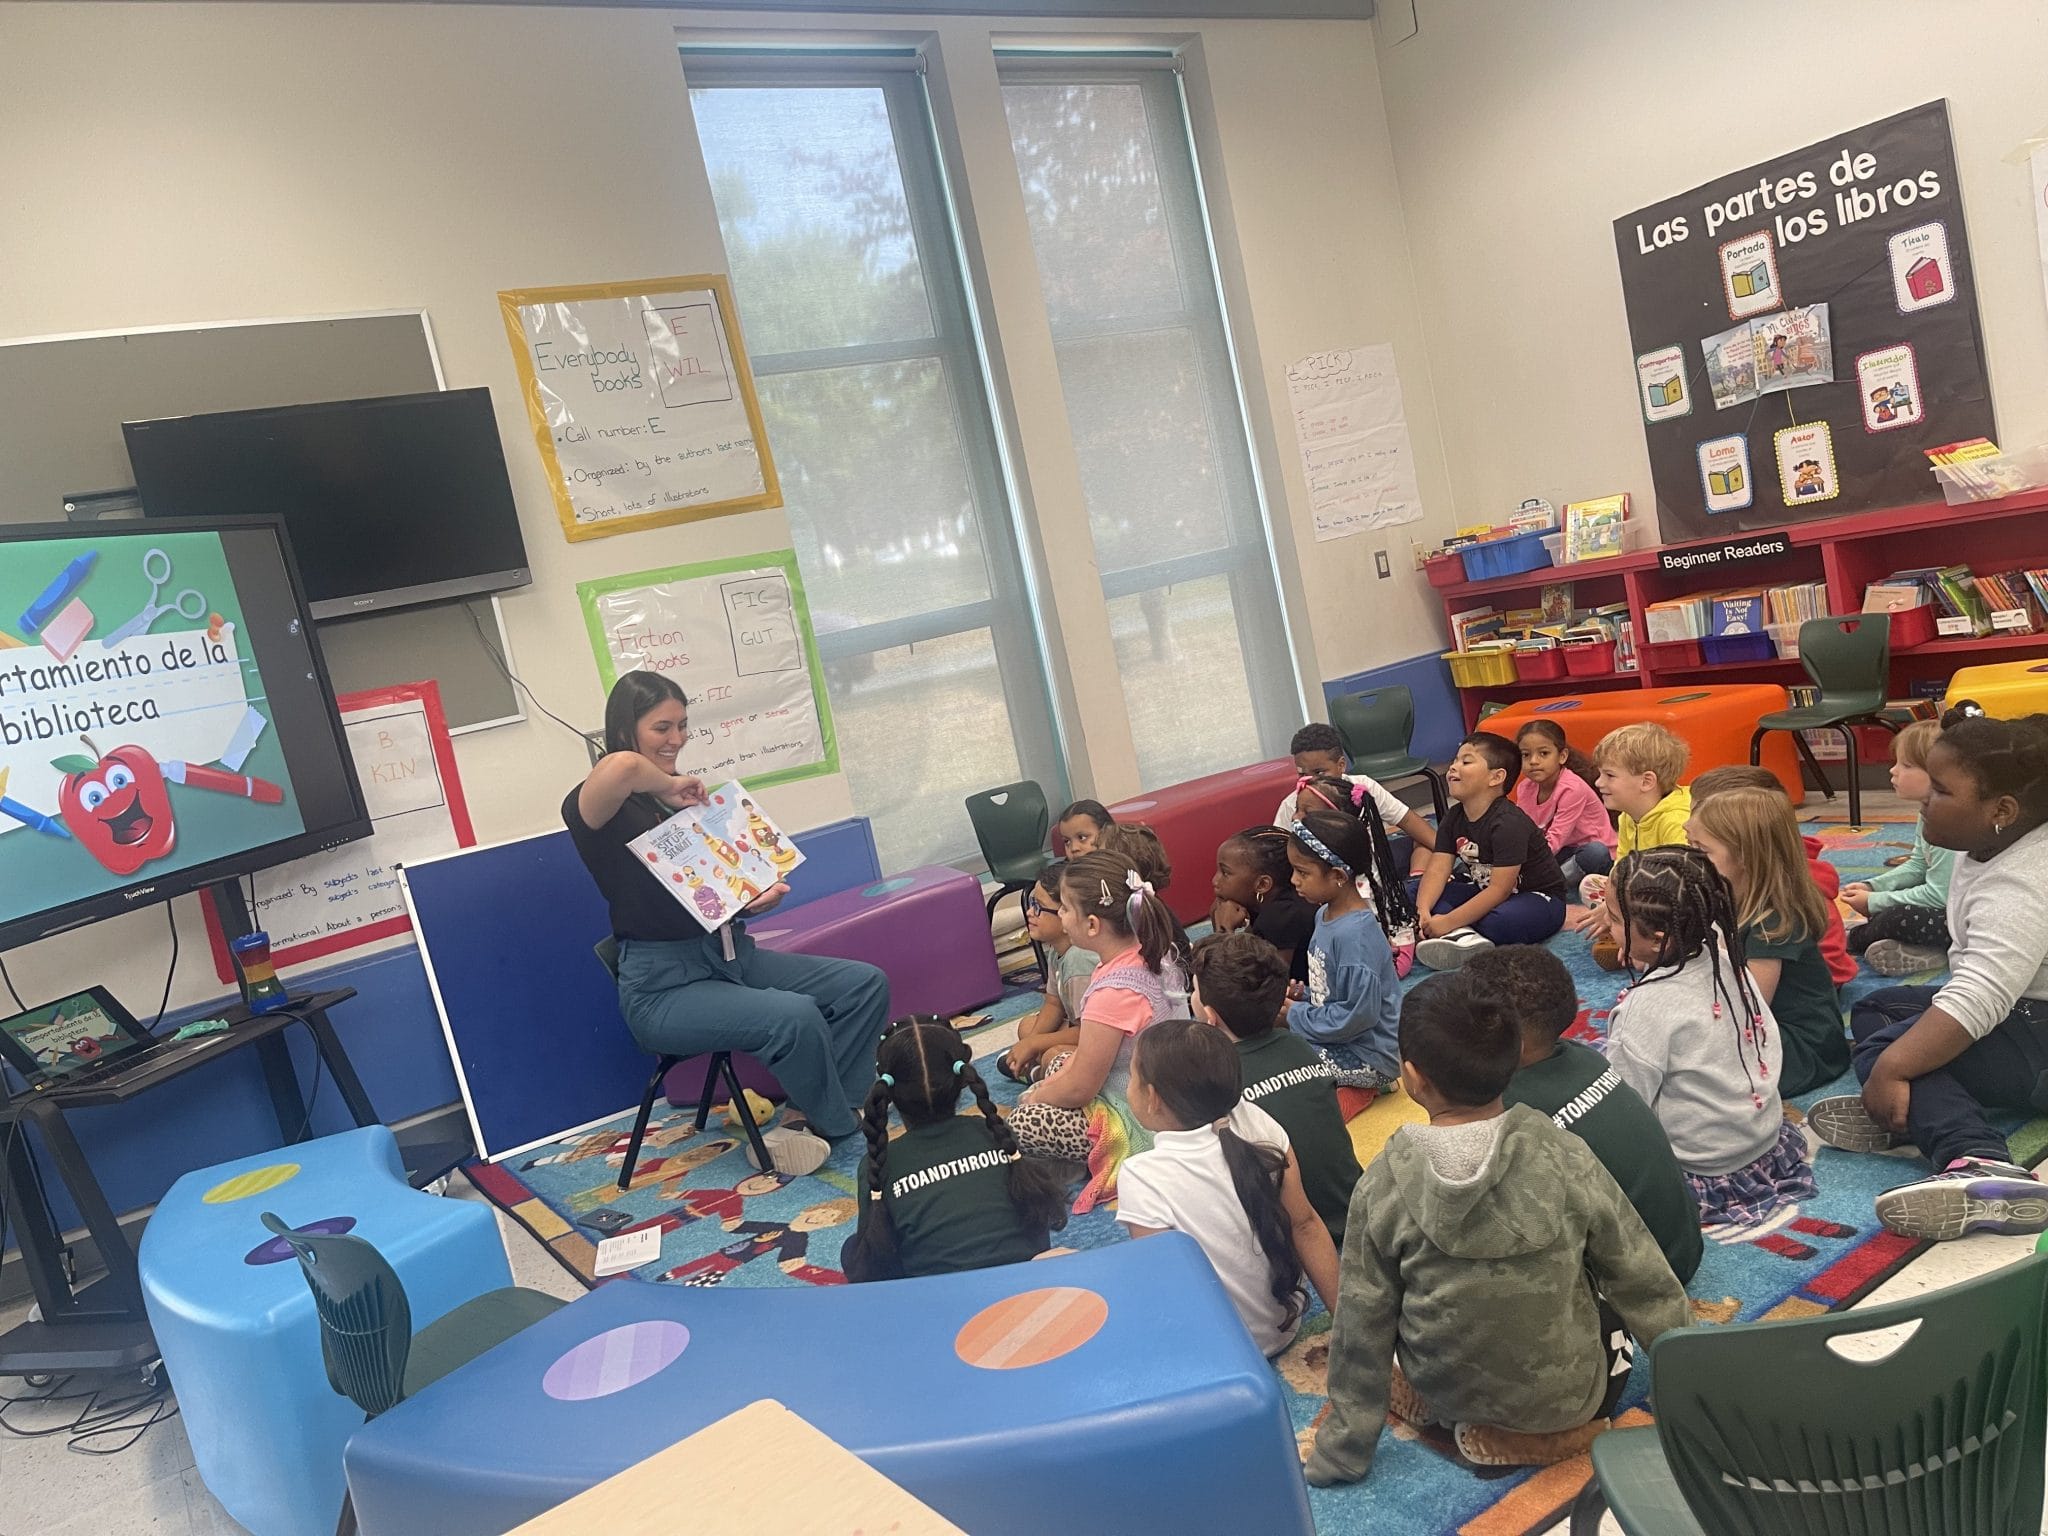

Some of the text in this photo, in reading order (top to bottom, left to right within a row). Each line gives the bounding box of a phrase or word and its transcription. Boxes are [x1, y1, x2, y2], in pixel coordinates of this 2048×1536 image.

[1637, 149, 1877, 255] Las partes de
[1775, 169, 1941, 247] los libros
[1727, 241, 1765, 260] Portada
[671, 316, 688, 336] E
[534, 342, 641, 376] Everybody
[664, 356, 712, 378] WIL
[591, 371, 643, 393] books
[565, 417, 665, 443] Call number: E
[1790, 433, 1815, 445] Autor
[1709, 446, 1736, 458] Lomo
[574, 462, 629, 487] Organized:
[635, 459, 652, 476] by
[655, 455, 671, 466] the
[623, 501, 642, 511] lots
[1663, 541, 1784, 569] Beginner Readers
[731, 590, 769, 610] FIC
[616, 623, 685, 653] Fiction
[741, 628, 773, 646] GUT
[161, 640, 196, 671] de
[201, 636, 229, 666] la
[640, 651, 690, 673] Books
[707, 685, 732, 701] FIC
[0, 698, 161, 745] biblioteca
[699, 727, 714, 745] by
[748, 713, 758, 722] or
[378, 731, 394, 749] B
[371, 757, 416, 784] KIN
[686, 767, 708, 777] more
[300, 884, 318, 897] By
[366, 866, 384, 876] last
[326, 917, 352, 932] About
[1242, 1063, 1332, 1101] OANDTHROUGH
[1552, 1066, 1621, 1129] #TOANDTHR
[892, 1149, 1011, 1198] #TOANDTHROUG
